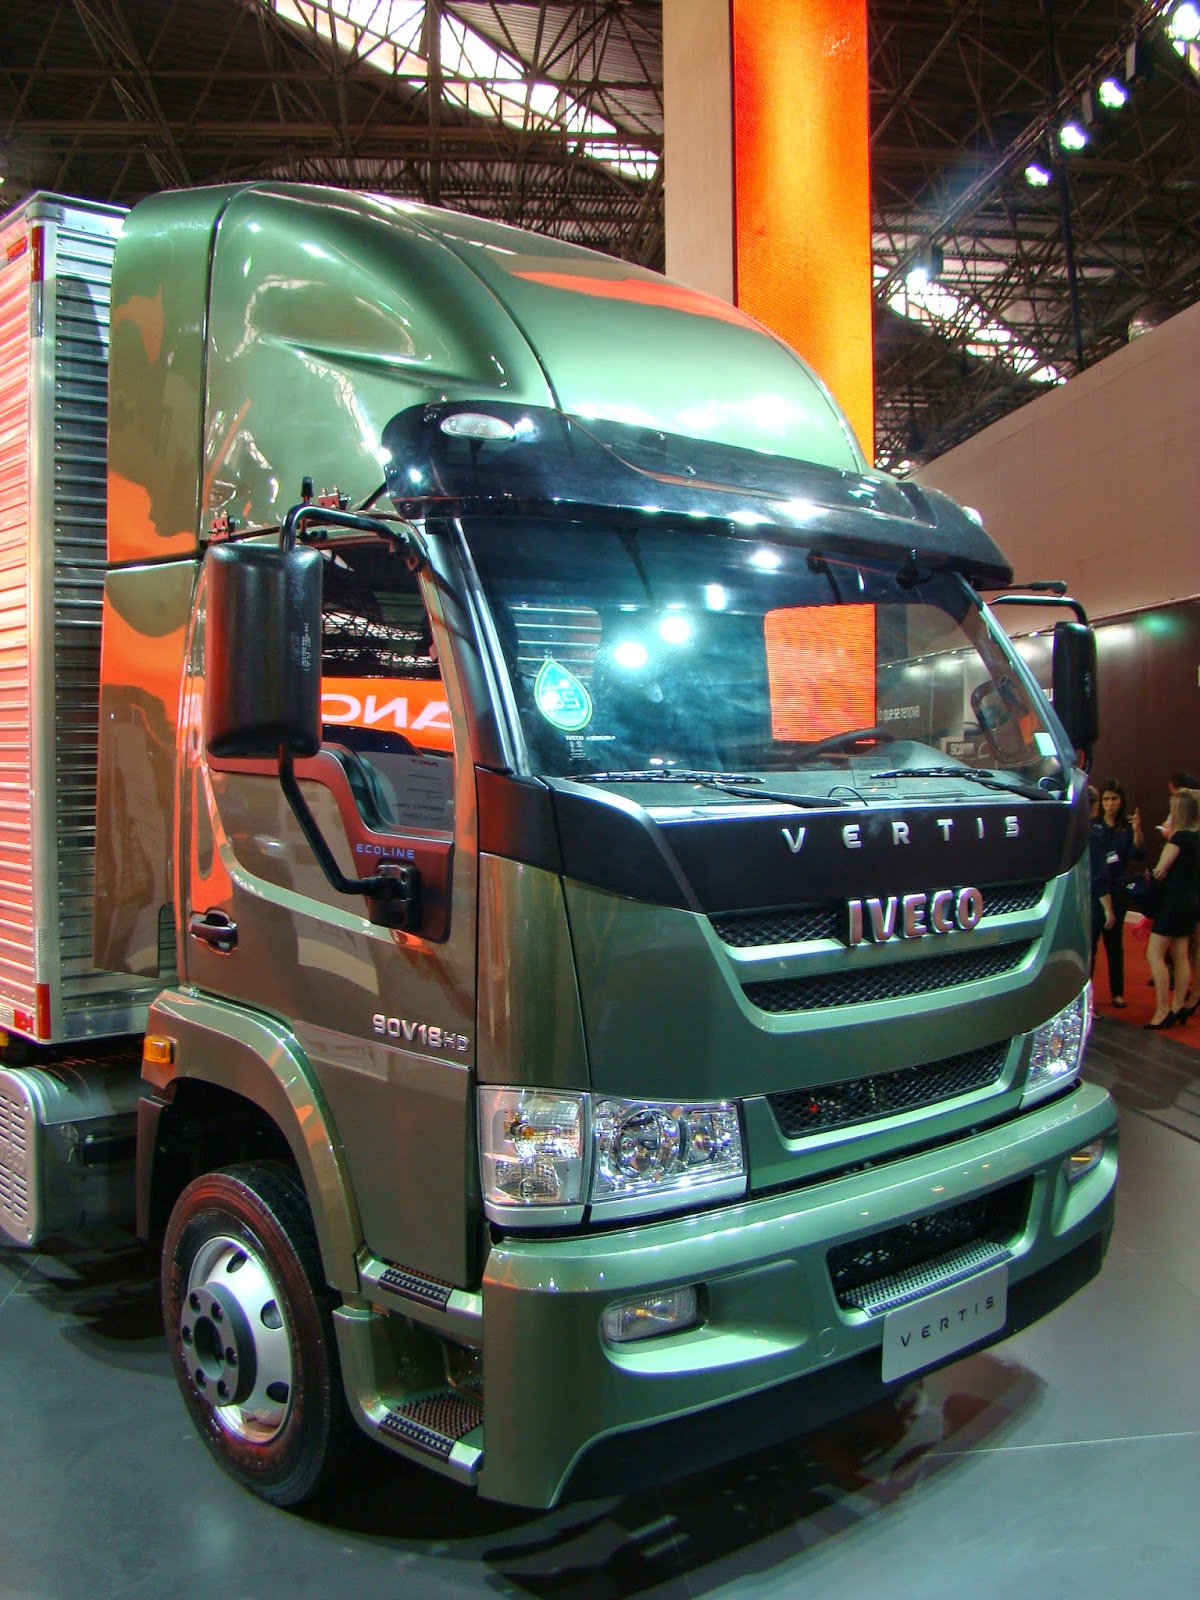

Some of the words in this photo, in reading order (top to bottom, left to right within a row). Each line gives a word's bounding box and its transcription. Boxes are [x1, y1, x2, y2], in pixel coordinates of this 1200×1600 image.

[356, 843, 415, 859] ECOLINE
[781, 815, 1020, 854] VERTIS
[848, 887, 983, 946] IVECO
[900, 1295, 995, 1348] VERTIS
